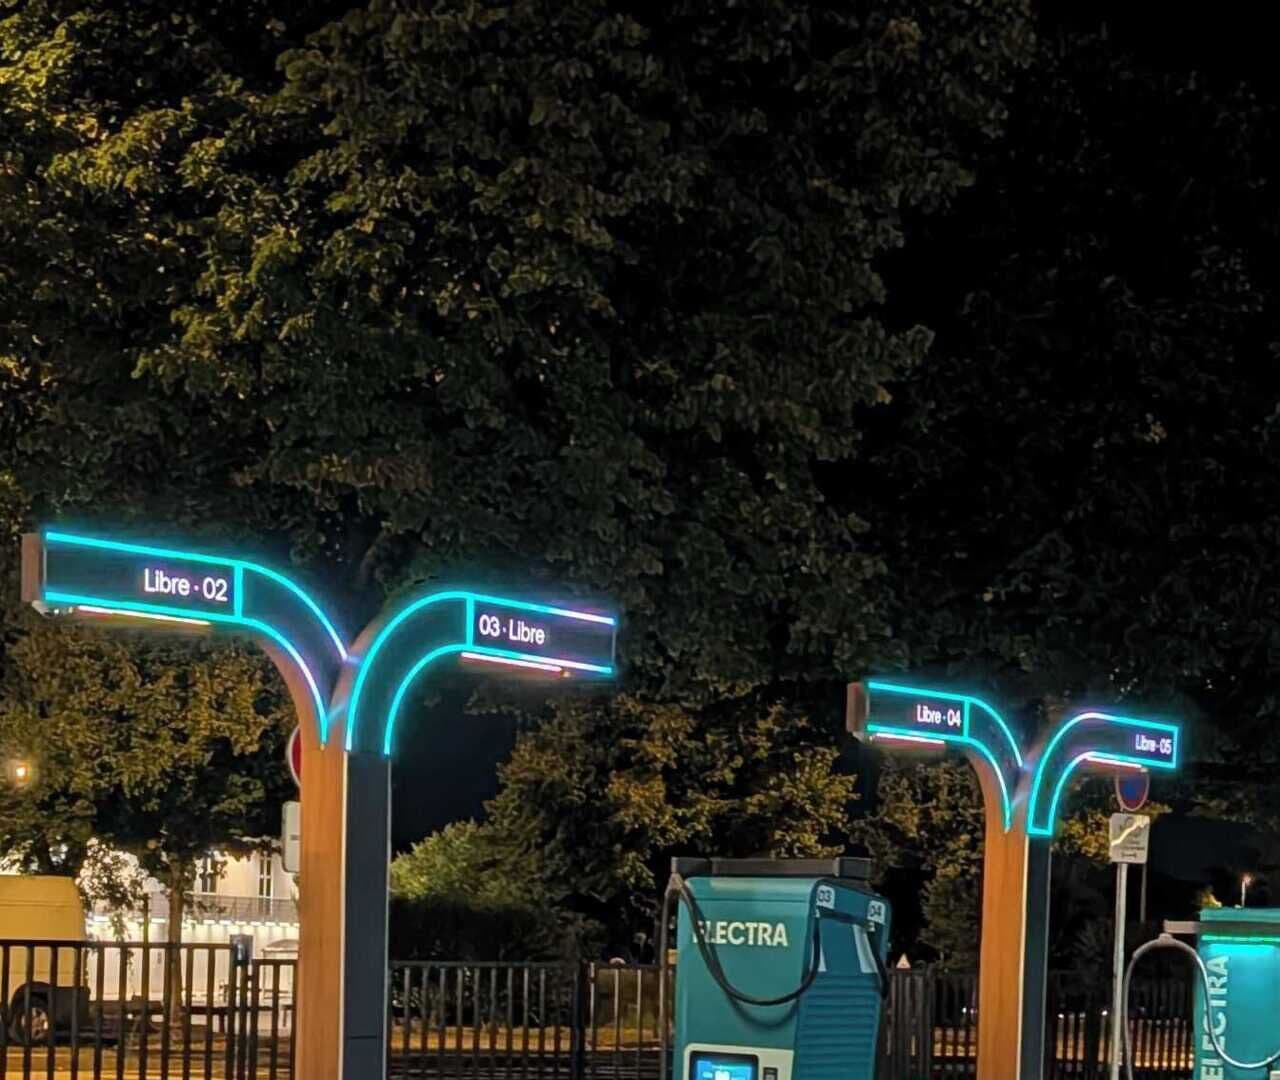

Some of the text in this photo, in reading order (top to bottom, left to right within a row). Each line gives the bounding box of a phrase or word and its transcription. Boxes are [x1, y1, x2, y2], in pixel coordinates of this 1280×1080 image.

[144, 567, 228, 602] Libre 02
[479, 614, 545, 645] 03 Libre
[917, 703, 942, 725] Libre
